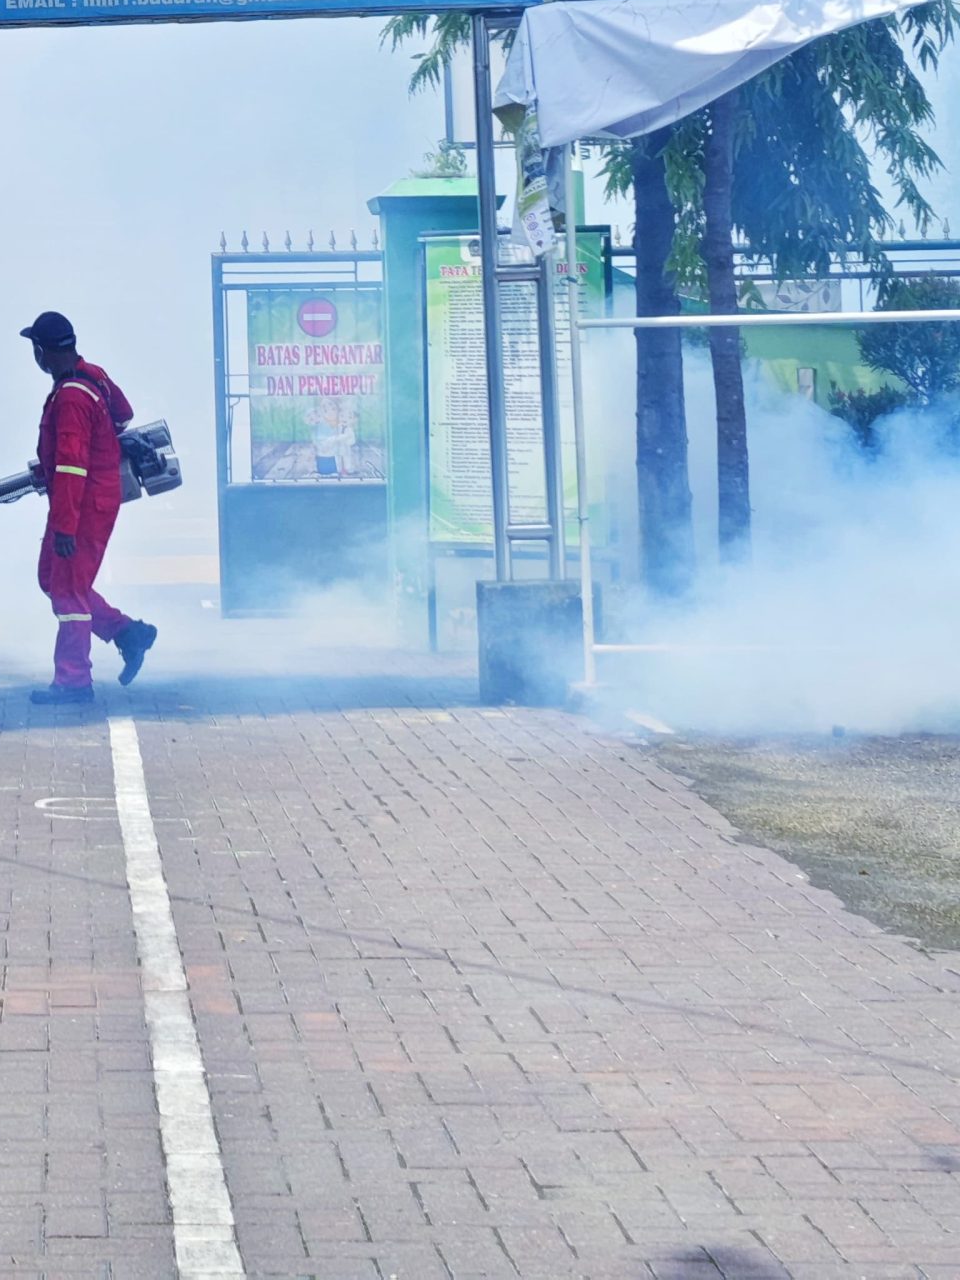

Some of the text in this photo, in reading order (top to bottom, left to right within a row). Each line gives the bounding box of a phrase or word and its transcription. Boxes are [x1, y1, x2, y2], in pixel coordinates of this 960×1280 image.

[257, 343, 384, 366] BATAS PENGANTAR
[266, 375, 376, 396] DAN PENJEMPUT
